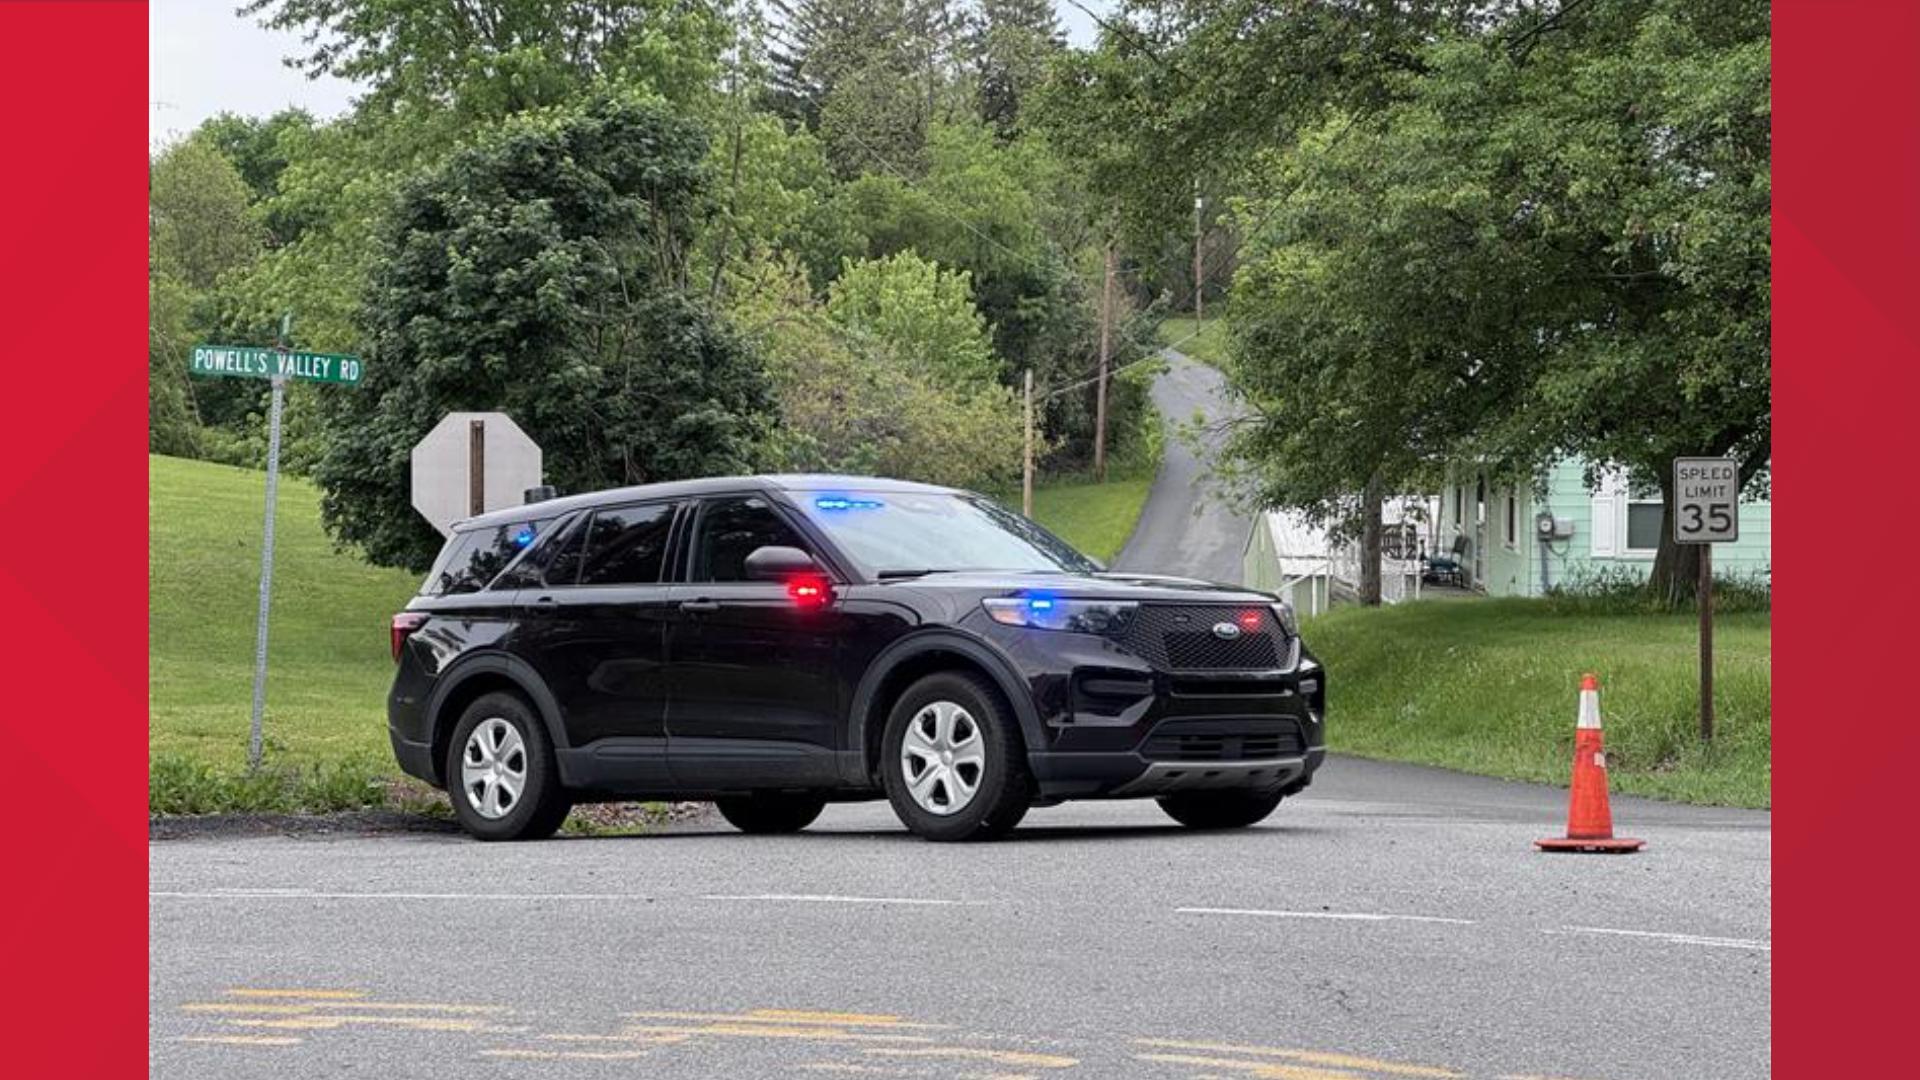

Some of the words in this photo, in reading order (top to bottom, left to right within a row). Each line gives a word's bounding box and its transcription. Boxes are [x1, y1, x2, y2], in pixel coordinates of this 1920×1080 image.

[195, 349, 268, 373] POWELL'S
[277, 354, 331, 378] VALLEY
[340, 359, 359, 381] RD
[1680, 467, 1733, 480] SPEED
[1685, 485, 1726, 498] LIMIT
[1682, 503, 1732, 533] 35
